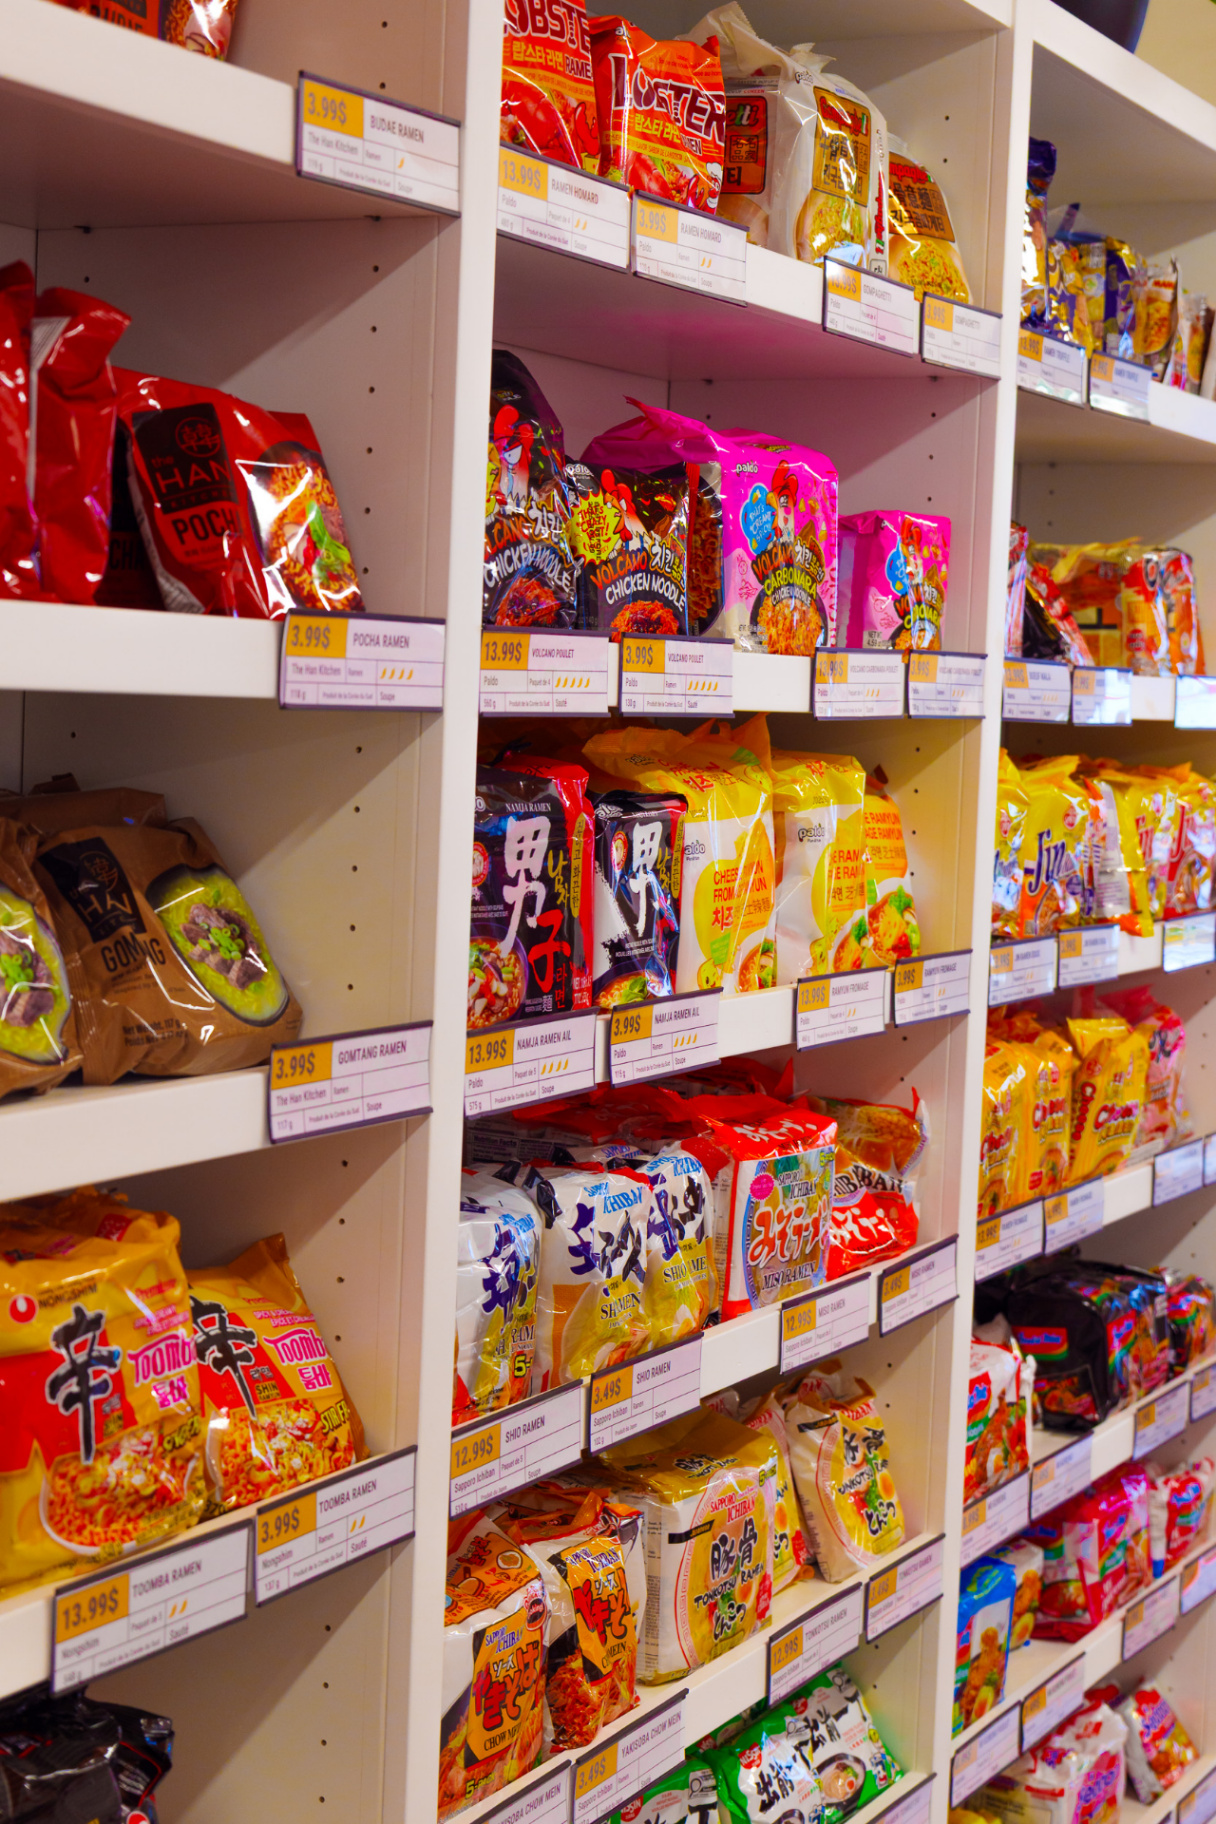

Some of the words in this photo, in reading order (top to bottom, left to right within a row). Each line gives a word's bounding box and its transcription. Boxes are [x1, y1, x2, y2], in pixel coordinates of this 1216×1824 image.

[308, 92, 347, 125] 3.99$
[370, 115, 396, 135] BUDAE
[398, 125, 424, 143] RAMEN
[308, 131, 320, 147] The
[335, 138, 359, 156] Kitchen
[502, 159, 541, 192] 13.99$
[501, 194, 517, 207] Paldo
[551, 180, 573, 196] RAMEN
[573, 186, 599, 204] HOMARD
[639, 208, 666, 233] 3.99$
[681, 222, 699, 239] RAMEN
[700, 227, 722, 244] HOMARD
[639, 239, 652, 253] Paldo
[926, 303, 945, 324] 3.99$
[736, 461, 758, 476] paldo
[590, 551, 648, 590] VOLCANO
[605, 572, 650, 605] CHICKEN
[652, 574, 685, 612] NOODLE
[764, 567, 817, 599] CARBONARA
[290, 624, 331, 651] 3.99$
[353, 632, 381, 648] POCHA
[382, 635, 410, 649] RAMEN
[484, 640, 522, 664] 13.99$
[532, 648, 555, 658] VOLCANO
[556, 648, 574, 658] POULET
[625, 645, 653, 666] 3.99$
[668, 653, 688, 663] VOLCANO
[689, 654, 704, 664] POULET
[292, 663, 303, 675] The
[305, 664, 317, 676] Han
[319, 664, 341, 676] Kitchen
[819, 659, 844, 677] 13.99$
[911, 659, 930, 676] 3.99$
[484, 676, 498, 686] Paldo
[625, 677, 638, 687] Paldo
[380, 691, 396, 702] Soupe
[505, 801, 528, 812] NAMJA
[529, 801, 551, 812] RAMEN
[711, 905, 734, 932] 치즈
[897, 967, 915, 986] 3.99$
[800, 986, 826, 1006] 13.99$
[832, 985, 849, 997] RAMYUN
[849, 980, 869, 994] FROMAGE
[614, 1015, 641, 1036] 3.99$
[654, 1012, 673, 1024] NAMJA
[673, 1010, 691, 1021] RAMEN
[692, 1009, 700, 1018] AIL
[517, 1036, 539, 1051] NAMJA
[540, 1032, 561, 1046] RAMEN
[562, 1030, 572, 1043] AIL
[338, 1046, 377, 1065] GOMTANG
[379, 1040, 407, 1057] RAMEN
[468, 1039, 507, 1065] 13.99$
[614, 1048, 626, 1058] Paldo
[675, 1056, 686, 1065] Soupe
[276, 1050, 315, 1080] 3.99$
[468, 1077, 483, 1089] Paldo
[541, 1085, 555, 1094] Soupe
[276, 1094, 288, 1106] The
[290, 1092, 303, 1104] Han
[303, 1088, 327, 1101] Kitchen
[366, 1102, 382, 1112] Soupe
[469, 1101, 478, 1111] 575
[784, 1261, 816, 1284] RAMEN
[818, 1304, 830, 1318] MISO
[830, 1298, 846, 1313] RAMEN
[786, 1309, 812, 1333] 12.99$
[298, 1364, 332, 1391] 툼바
[636, 1369, 650, 1384] SHIO
[650, 1361, 671, 1378] RAMEN
[255, 1381, 279, 1396] SHIN
[594, 1377, 621, 1405] 3.49$
[593, 1413, 611, 1427] Sapporo
[612, 1406, 628, 1418] Ichiban
[505, 1428, 521, 1443] SHIO
[522, 1415, 546, 1435] RAMEN
[454, 1436, 494, 1469] 12.99$
[501, 1460, 513, 1470] Paquet
[514, 1457, 520, 1466] de
[520, 1455, 523, 1463] 5
[454, 1477, 475, 1493] Sapporo
[476, 1468, 495, 1482] Ichiban
[528, 1468, 541, 1479] Soupe
[318, 1492, 350, 1514] TOOMBA
[351, 1479, 377, 1501] RAMEN
[710, 1493, 737, 1513] SAPPORO
[261, 1508, 299, 1543] 3.99$
[318, 1533, 334, 1544] Ramen
[350, 1537, 368, 1553] Sauté
[262, 1549, 293, 1570] Nongshim
[132, 1577, 170, 1598] TOOMBA
[171, 1560, 202, 1581] RAMEN
[694, 1577, 737, 1609] TONKOTSU
[741, 1562, 764, 1585] RAMEN
[870, 1578, 889, 1601] 3.49$
[63, 1586, 119, 1630] 13.99$
[805, 1620, 829, 1641] TONKOTSU
[830, 1609, 847, 1626] RAMEN
[773, 1636, 799, 1666] 12.99$
[472, 1639, 541, 1732] やきそば
[483, 1732, 507, 1752] CHOW
[621, 1732, 650, 1758] YAKISOBA
[650, 1718, 667, 1740] CHOW
[668, 1711, 681, 1728] MEIN
[578, 1756, 607, 1790] 3.49$
[525, 1796, 543, 1815] CHOW
[545, 1782, 562, 1802] MEIN
[578, 1794, 596, 1812] Sapporo
[597, 1783, 613, 1799] Ichiban
